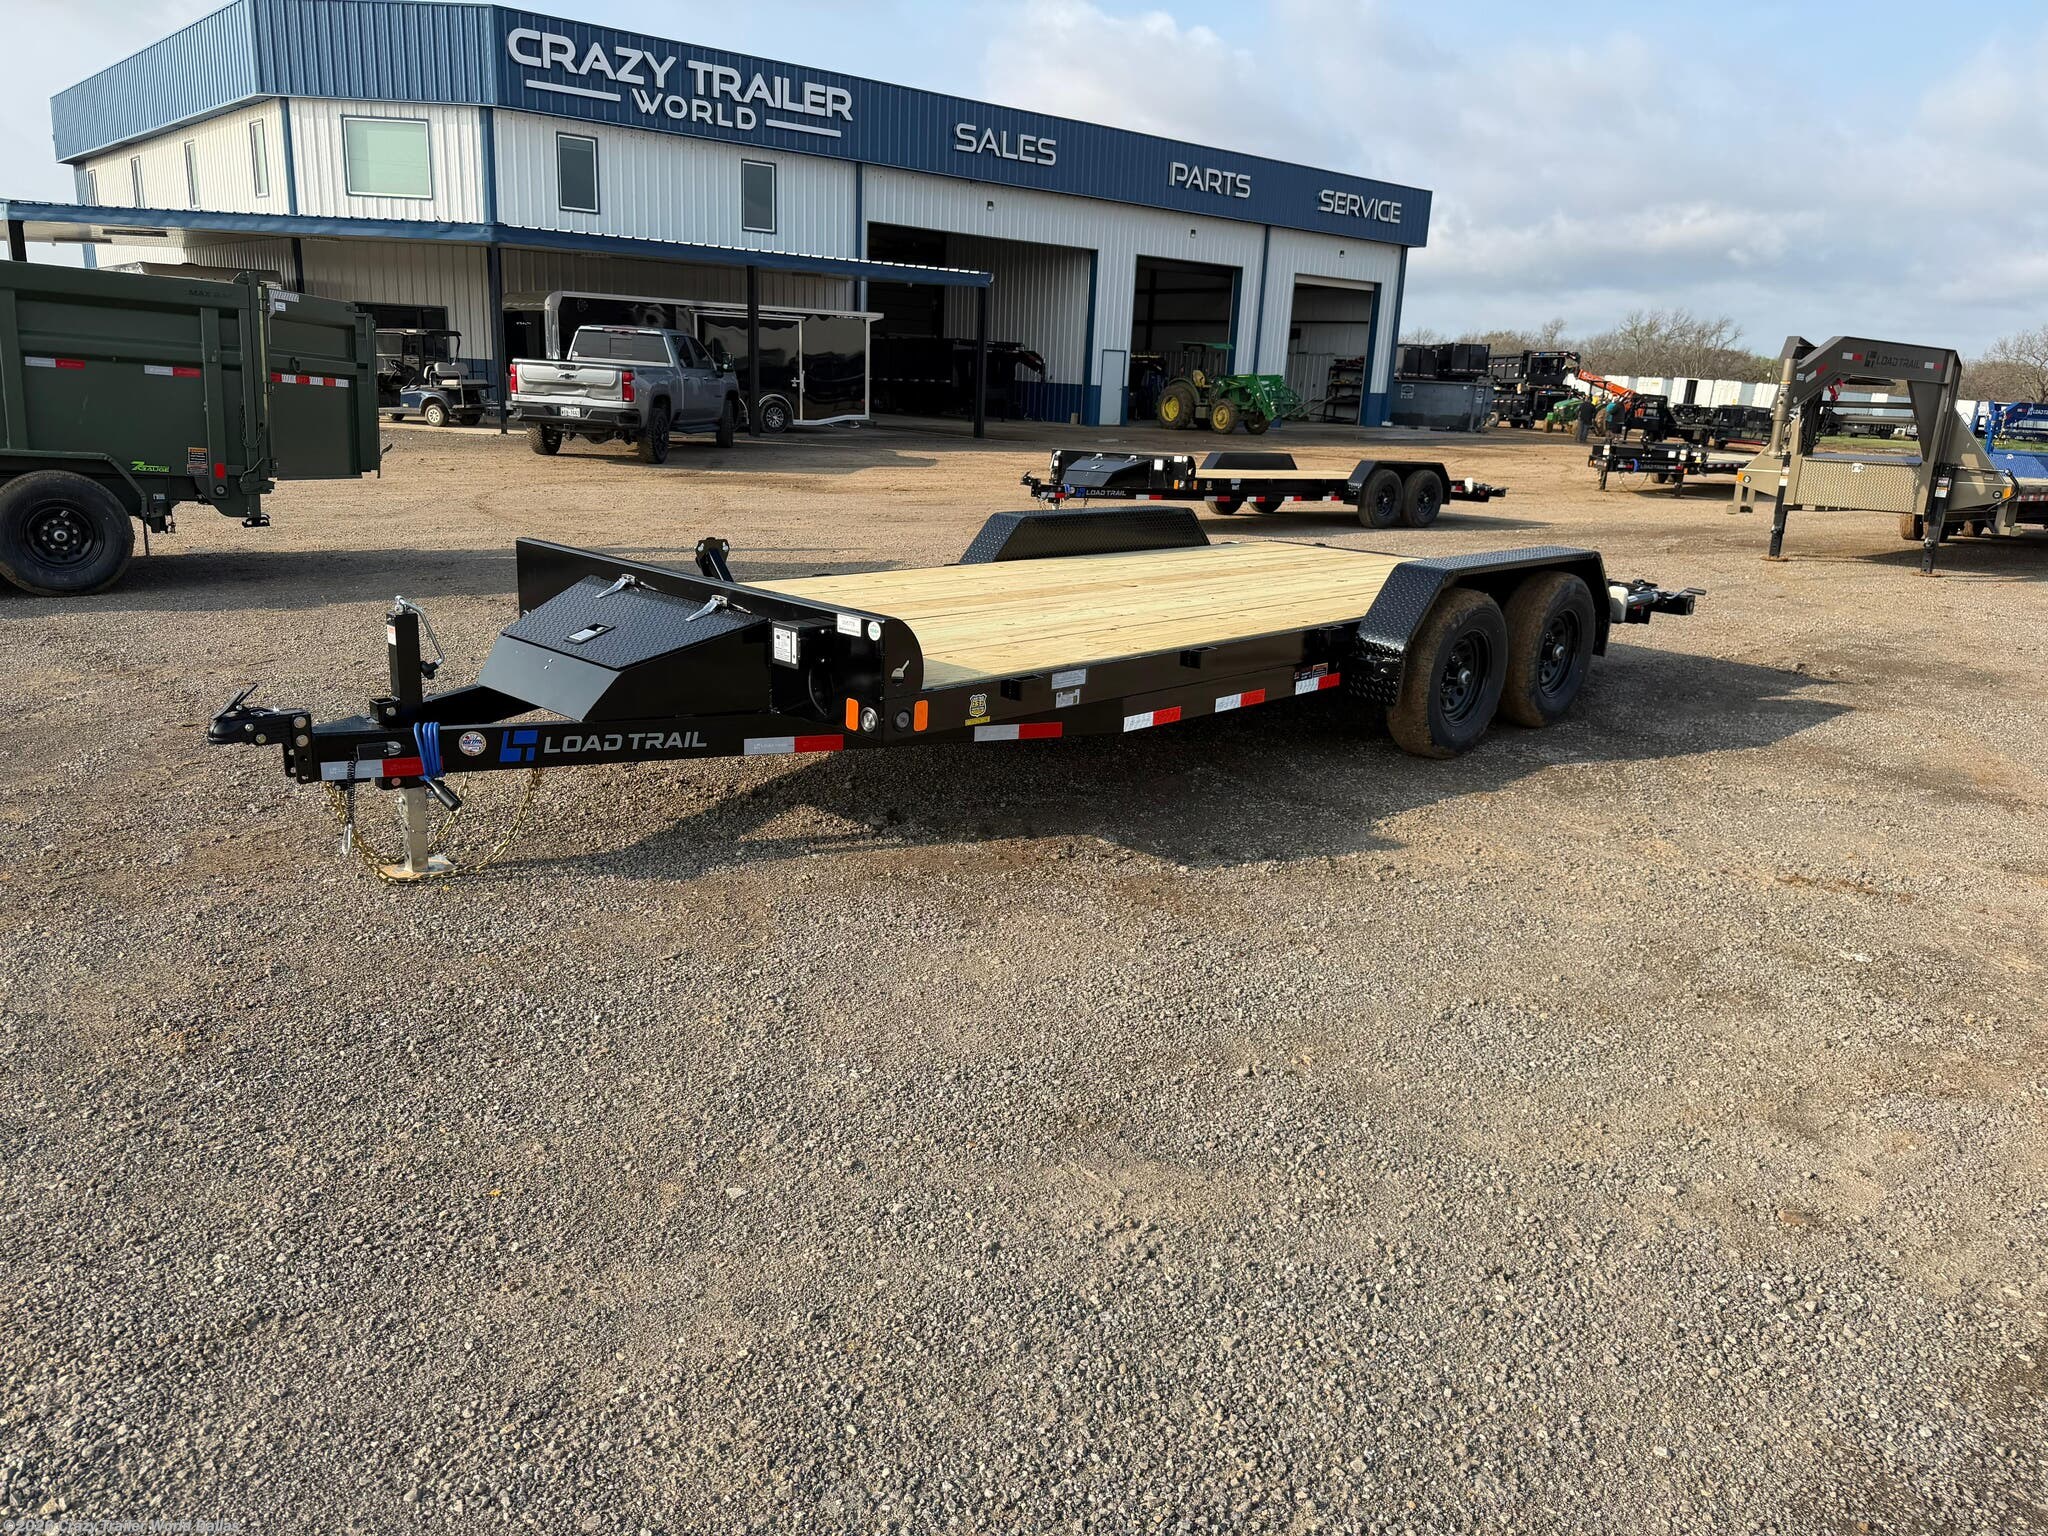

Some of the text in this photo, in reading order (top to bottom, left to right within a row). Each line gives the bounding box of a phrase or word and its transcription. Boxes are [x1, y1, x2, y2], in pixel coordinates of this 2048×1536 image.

[508, 27, 853, 121] CRAZY TRAILER
[631, 87, 757, 131] WORLD
[954, 122, 1057, 166] SALES
[1168, 161, 1252, 199] PARTS
[1317, 188, 1402, 224] SERVICE
[1876, 355, 1898, 367] LOAD
[1898, 358, 1921, 370] TRAIL
[543, 734, 623, 754] LOAD
[628, 731, 708, 750] TRAIL
